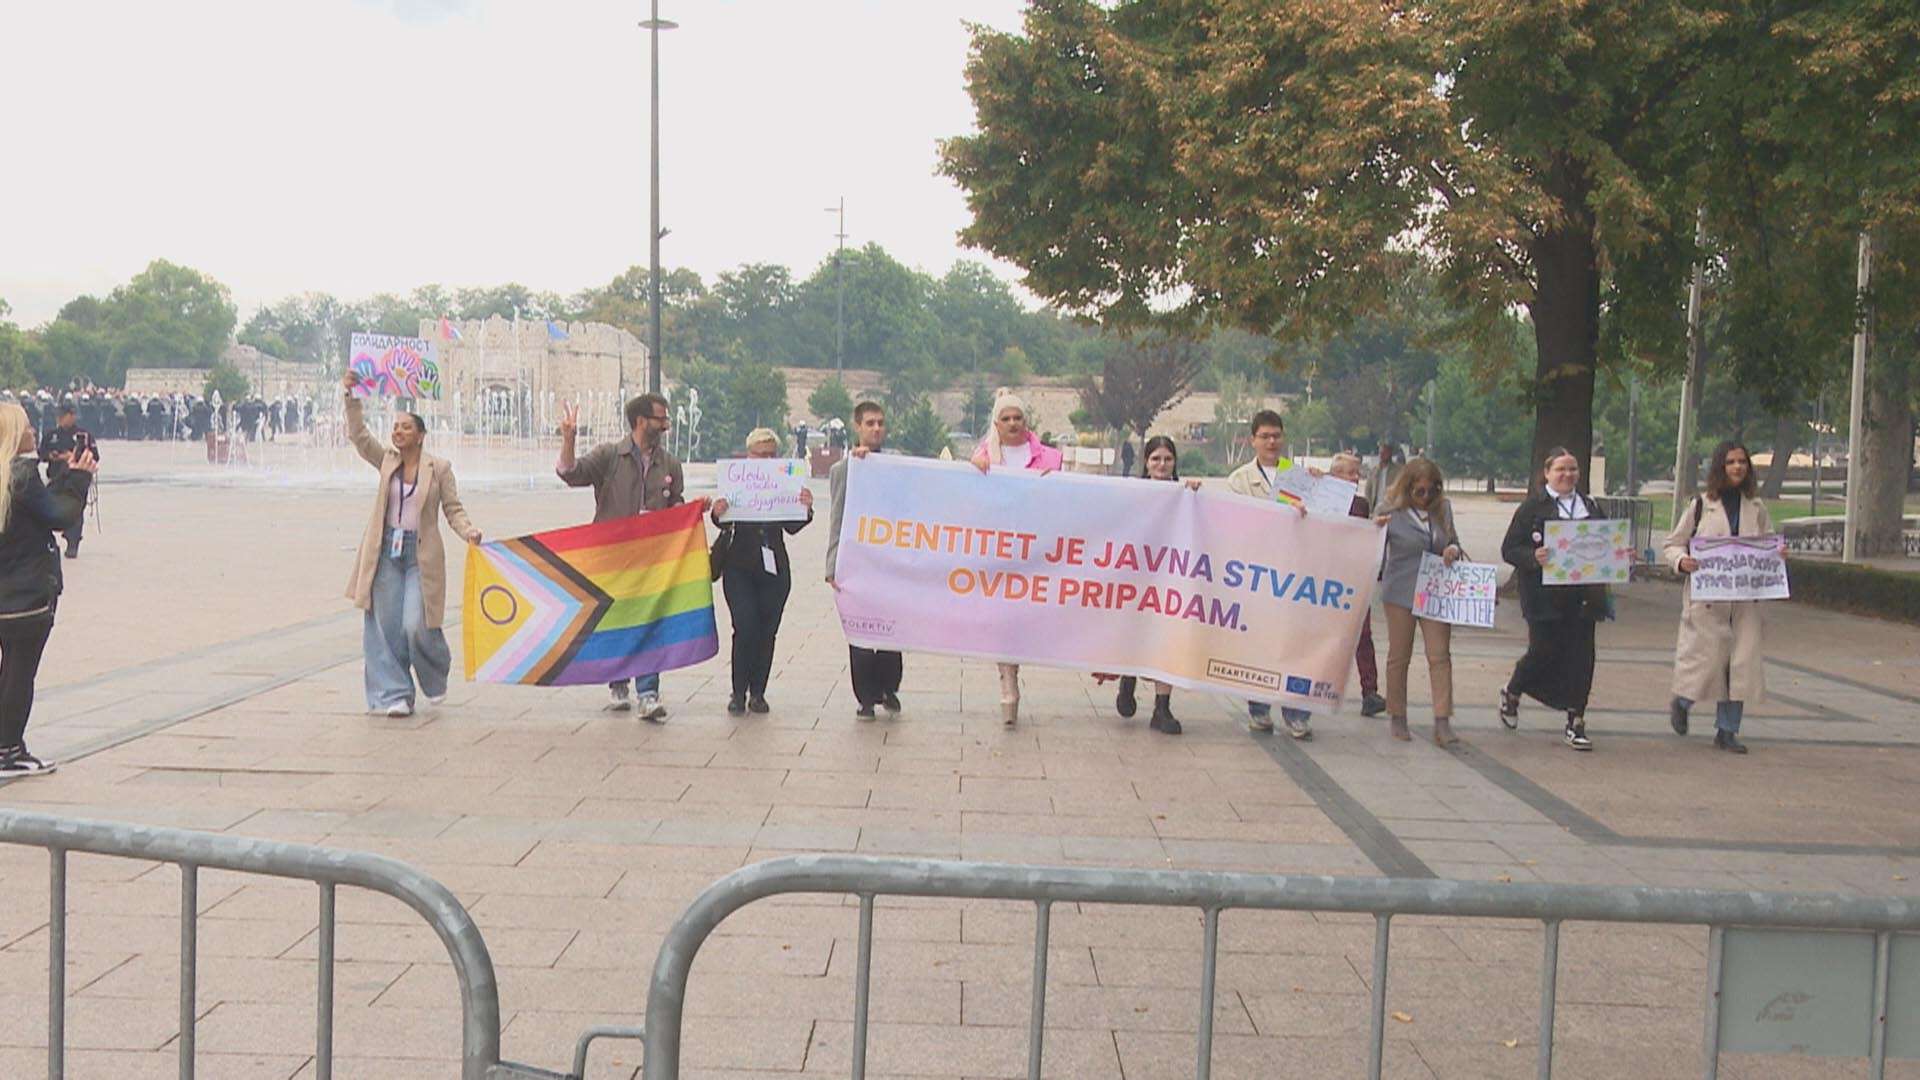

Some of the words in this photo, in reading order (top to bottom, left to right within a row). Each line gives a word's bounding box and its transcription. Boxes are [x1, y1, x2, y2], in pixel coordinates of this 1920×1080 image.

[857, 515, 1037, 561] IDENTITET
[1045, 536, 1085, 566] JE
[1094, 541, 1213, 582] JAVNA
[1223, 560, 1354, 610] STVAR:
[1447, 565, 1497, 584] MESTA
[1444, 579, 1467, 597] SVE
[948, 567, 1049, 603] OVDE
[1058, 578, 1248, 632] PRIPADAM.
[1213, 665, 1275, 684] HEARTEFACT
